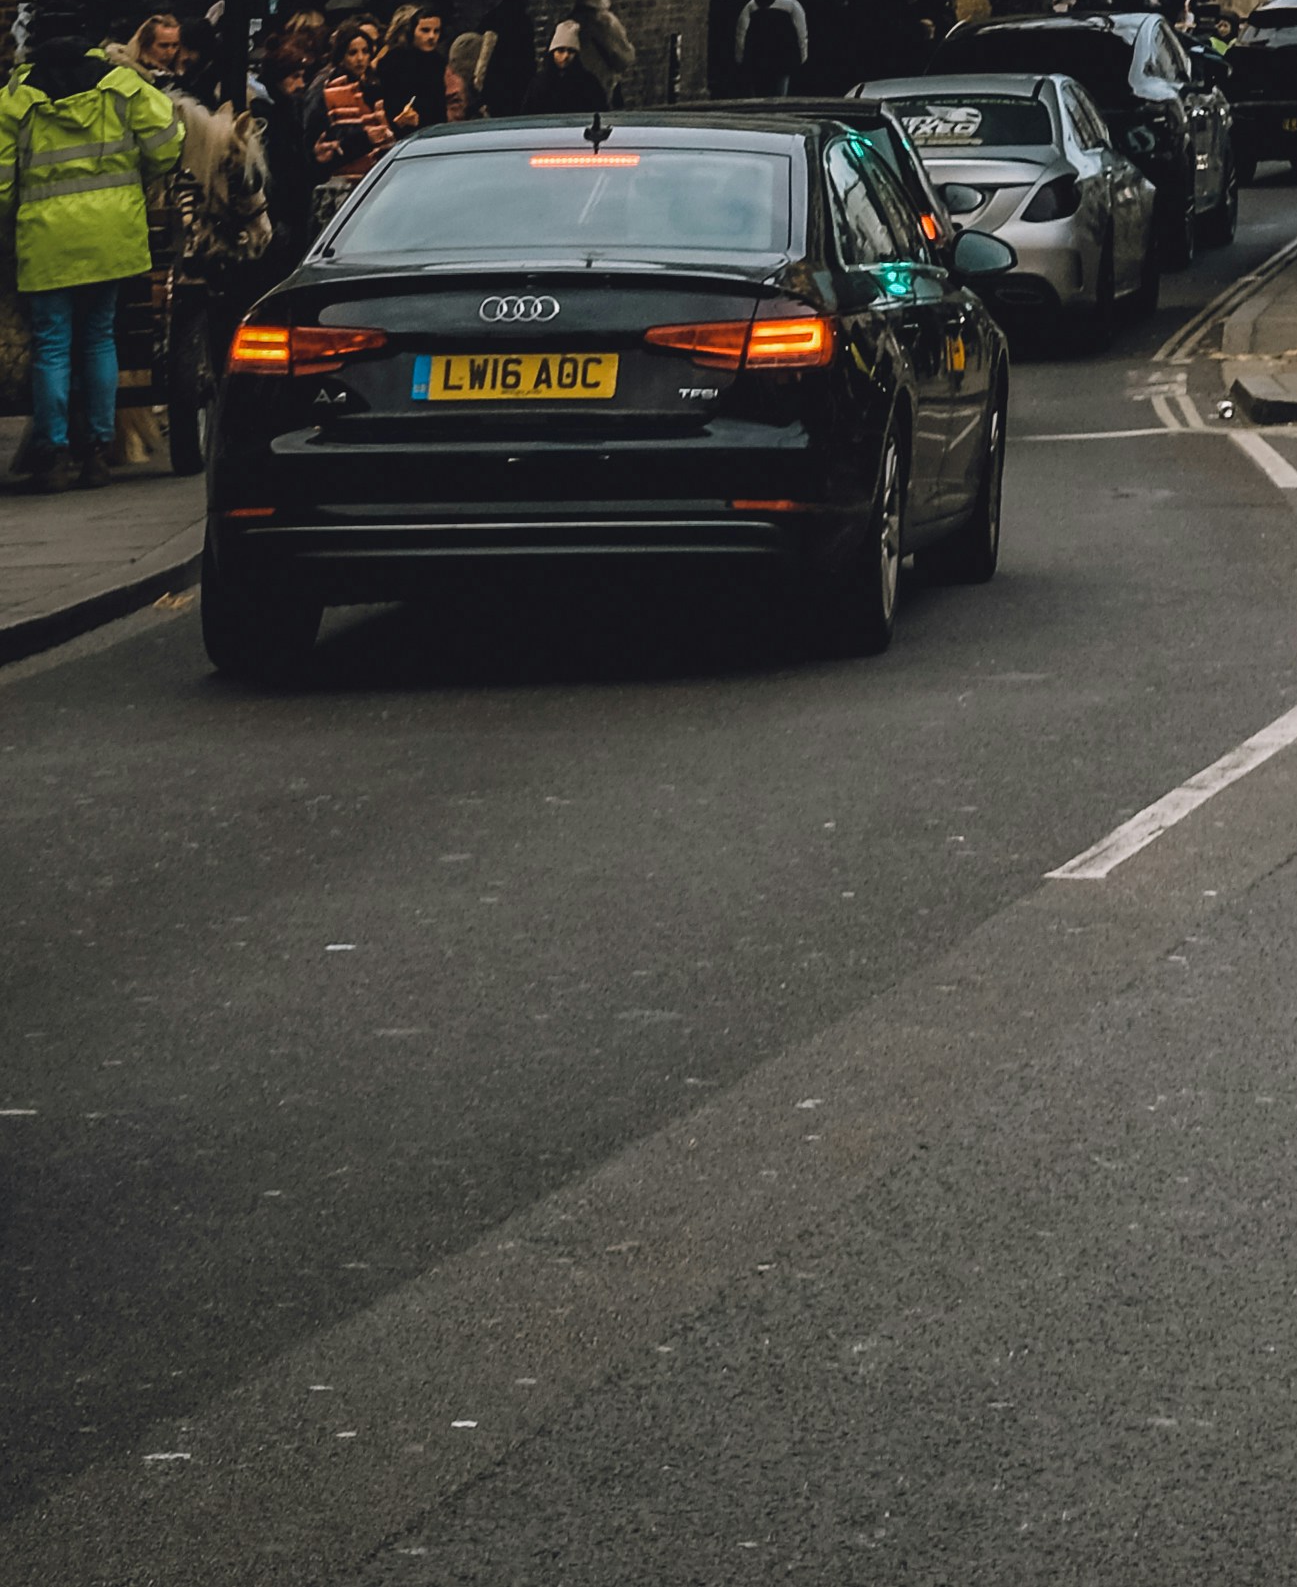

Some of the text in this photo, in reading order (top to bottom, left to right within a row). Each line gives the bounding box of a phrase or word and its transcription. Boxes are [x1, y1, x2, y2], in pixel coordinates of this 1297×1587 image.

[443, 356, 603, 392] LW16 AOC
[314, 388, 347, 404] A4
